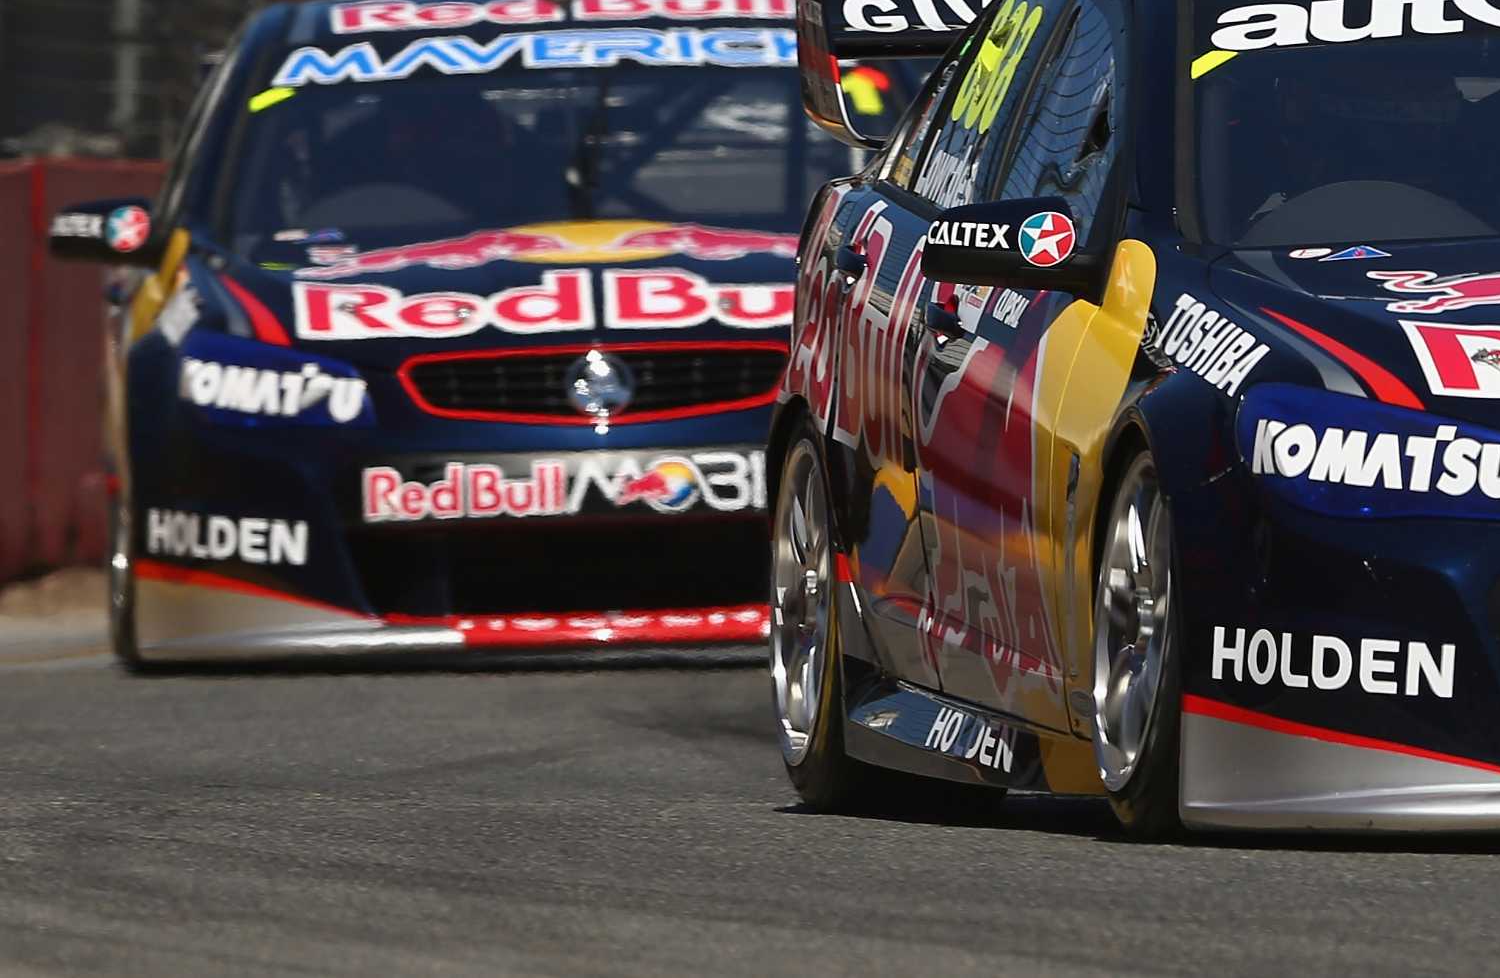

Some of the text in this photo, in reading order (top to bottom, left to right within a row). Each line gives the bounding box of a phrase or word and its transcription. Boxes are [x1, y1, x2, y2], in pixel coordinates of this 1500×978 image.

[927, 220, 1010, 250] CALTEX
[292, 269, 596, 339] Red
[1154, 293, 1271, 398] TOSHIBA
[147, 508, 308, 565] HOLDEN
[1211, 626, 1456, 698] HOLDEN
[924, 707, 1013, 773] HODEN
